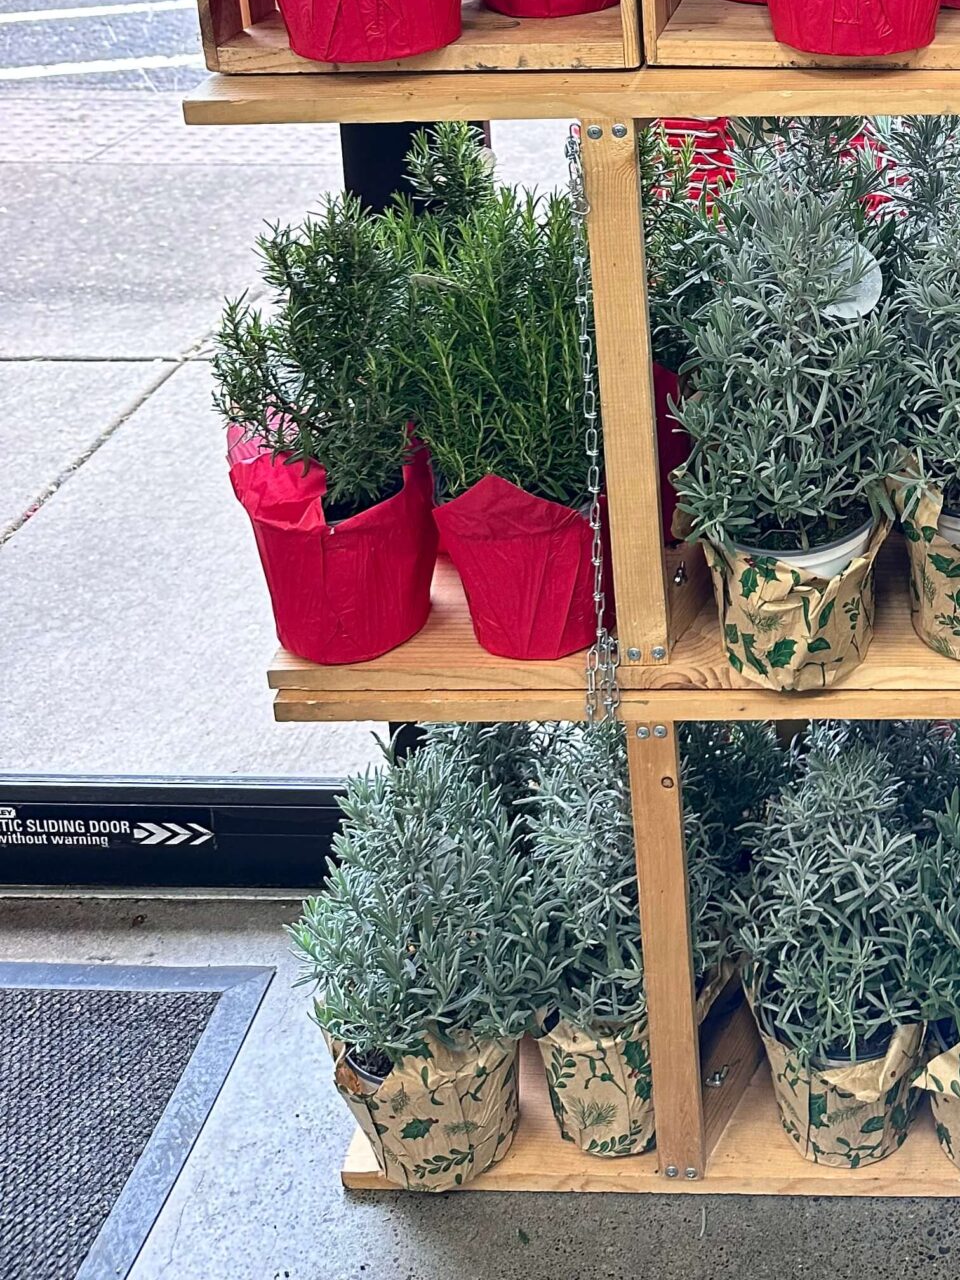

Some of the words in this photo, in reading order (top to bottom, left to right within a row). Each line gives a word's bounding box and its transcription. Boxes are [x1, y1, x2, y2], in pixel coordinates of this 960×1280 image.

[26, 819, 85, 833] SLIDING
[90, 821, 130, 833] DOOR
[50, 834, 109, 847] warning
